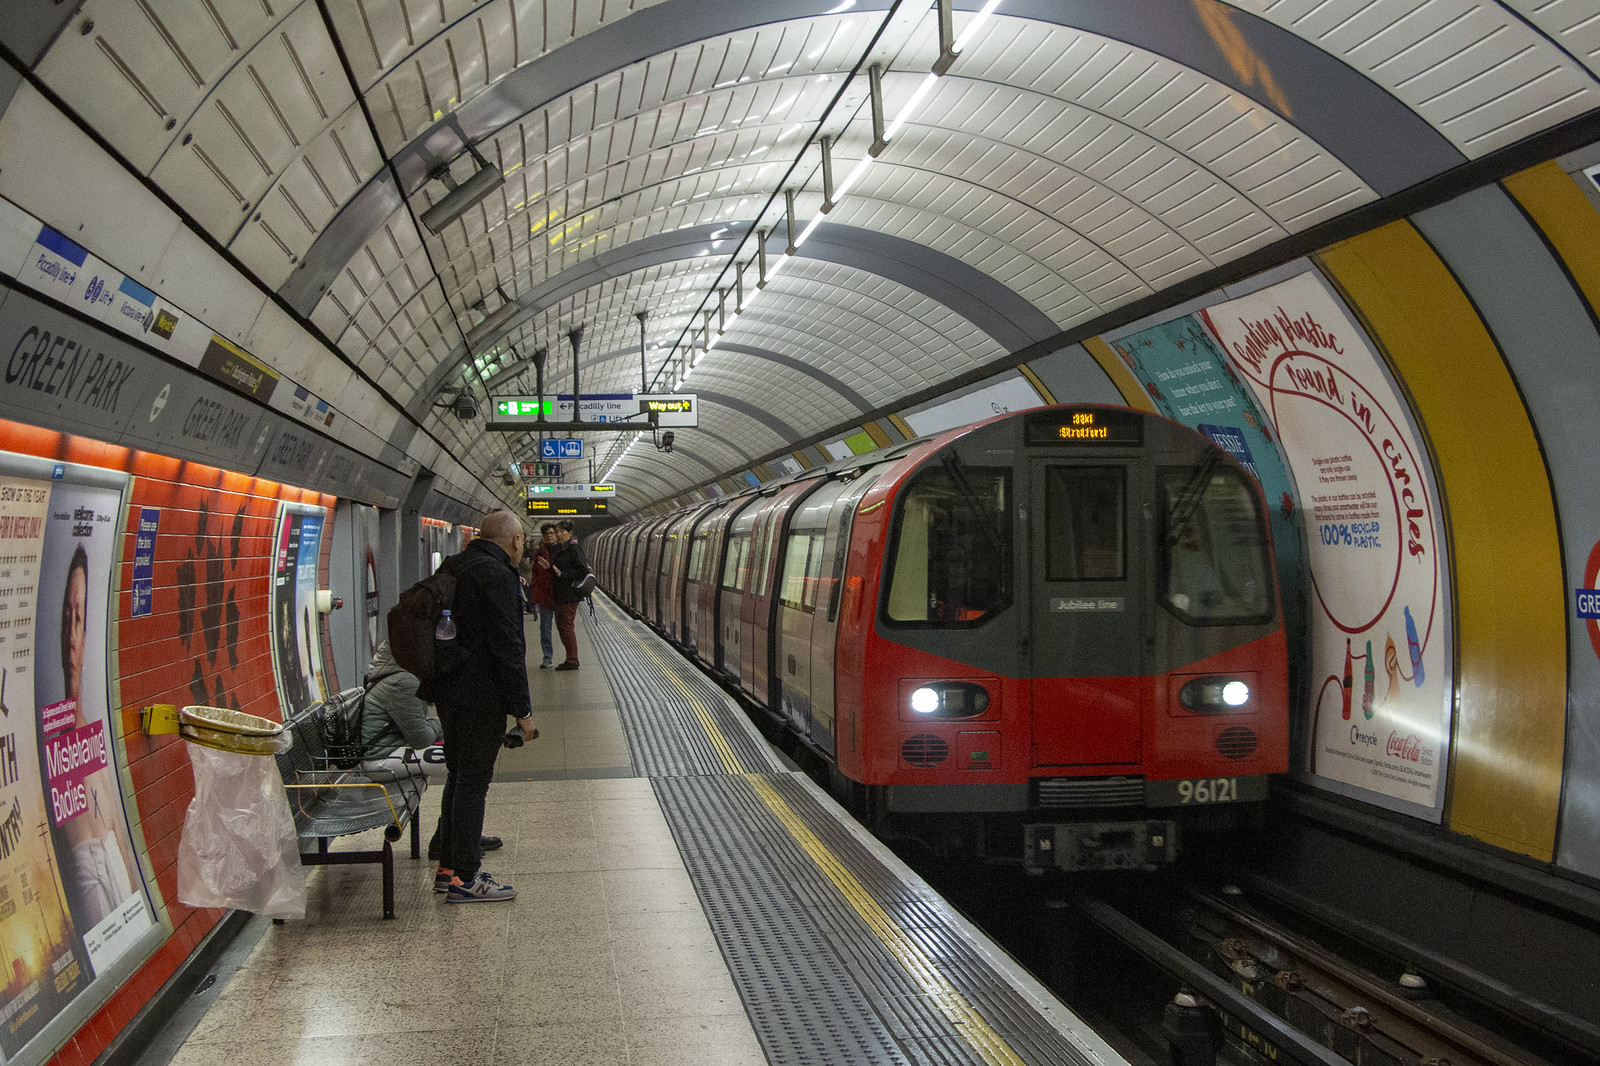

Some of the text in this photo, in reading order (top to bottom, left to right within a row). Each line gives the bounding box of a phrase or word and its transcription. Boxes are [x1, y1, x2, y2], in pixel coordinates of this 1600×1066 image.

[36, 253, 71, 284] Piccadilly line
[120, 300, 144, 324] Victoria line
[1274, 306, 1344, 355] plastic
[5, 325, 136, 414] GREEN PARK
[1284, 363, 1344, 405] round
[606, 402, 622, 410] line
[649, 401, 683, 412] Way out
[1351, 391, 1376, 434] in
[181, 396, 250, 450] GREEN PARK
[1212, 433, 1245, 453] JESSIE
[1, 486, 16, 502] SHOW
[1382, 438, 1426, 565] circles
[72, 522, 93, 537] collection
[1319, 523, 1353, 546] 100%
[1351, 521, 1381, 535] RECYCLED
[1058, 600, 1118, 611] Jubilee line
[1358, 731, 1378, 748] recycle
[45, 727, 107, 780] Misbehaving
[51, 780, 87, 822] Bodies
[1177, 777, 1237, 804] 96121
